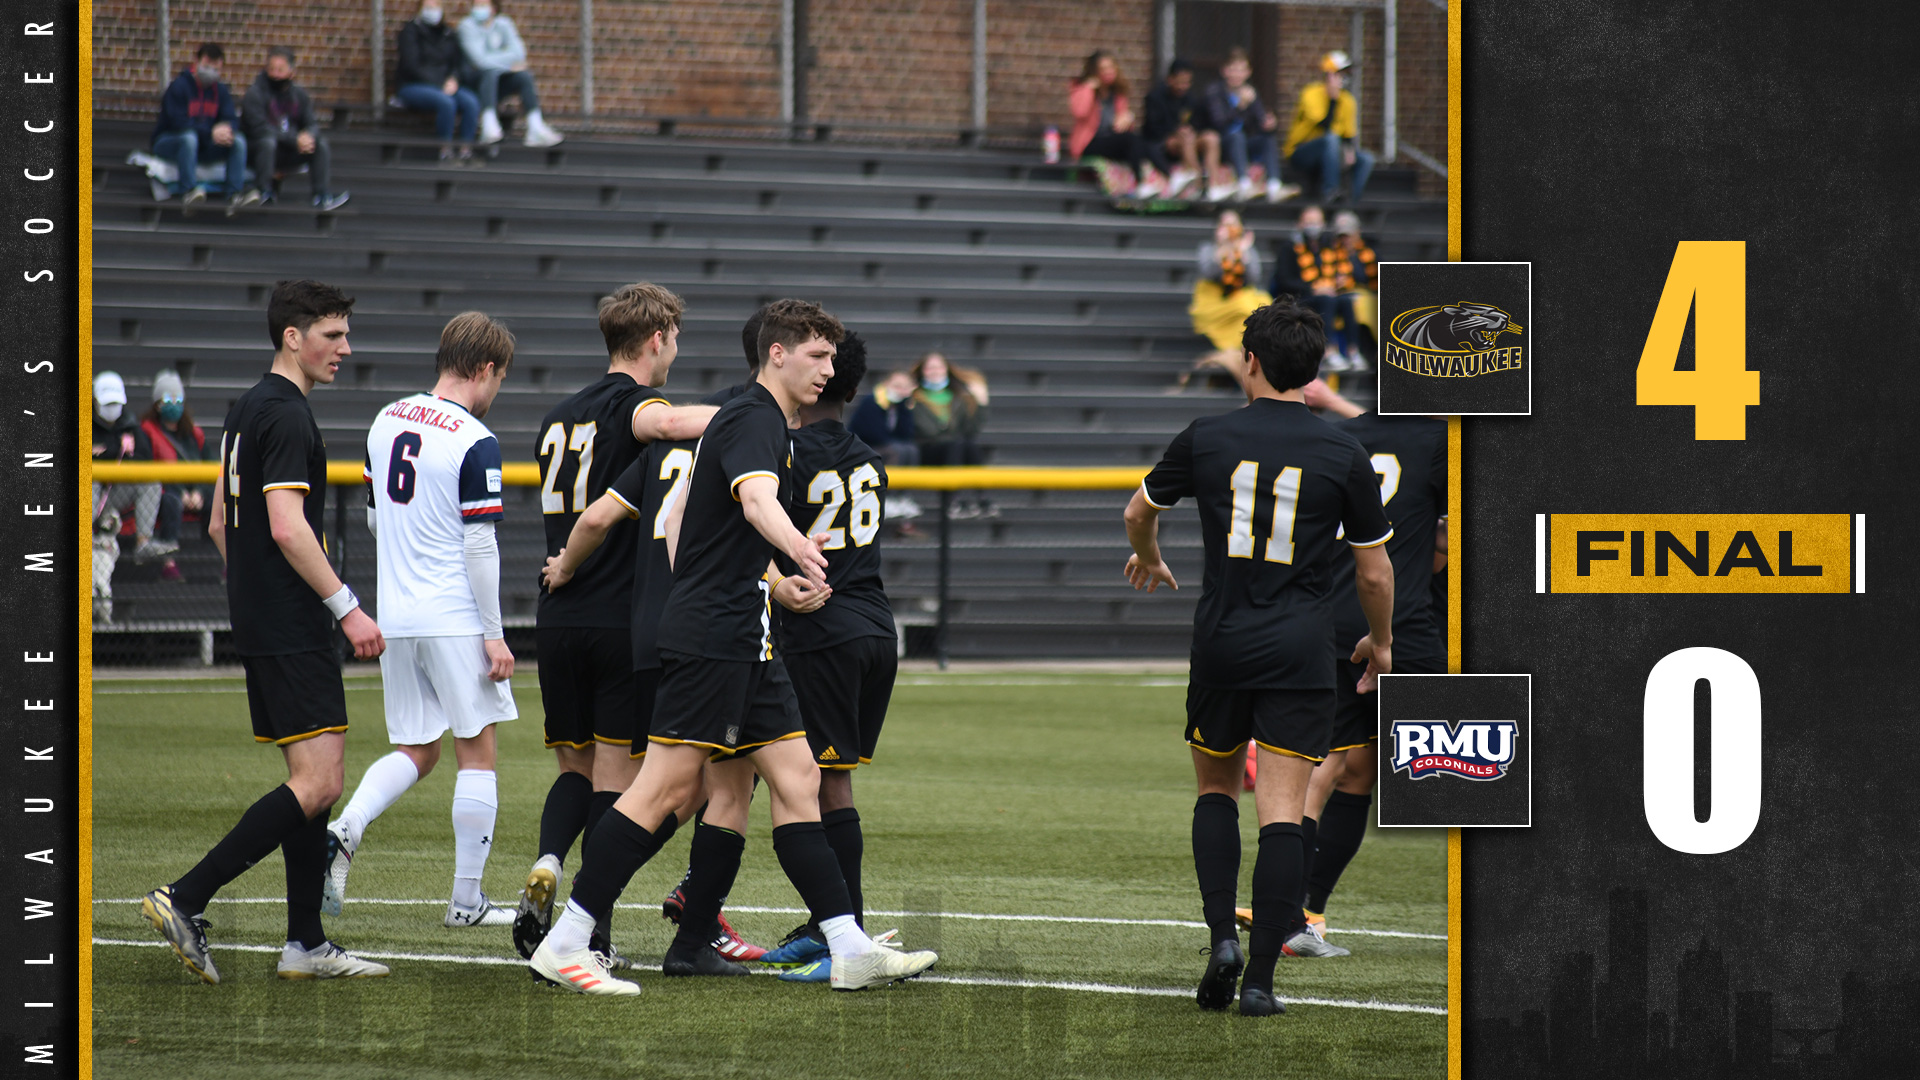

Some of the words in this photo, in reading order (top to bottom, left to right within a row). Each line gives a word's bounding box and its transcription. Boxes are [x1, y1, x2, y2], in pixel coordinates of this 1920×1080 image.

[385, 401, 465, 433] COLONIALS
[387, 430, 422, 506] 6
[540, 421, 597, 514] 27
[806, 462, 880, 550] 26
[1228, 460, 1302, 566] 11
